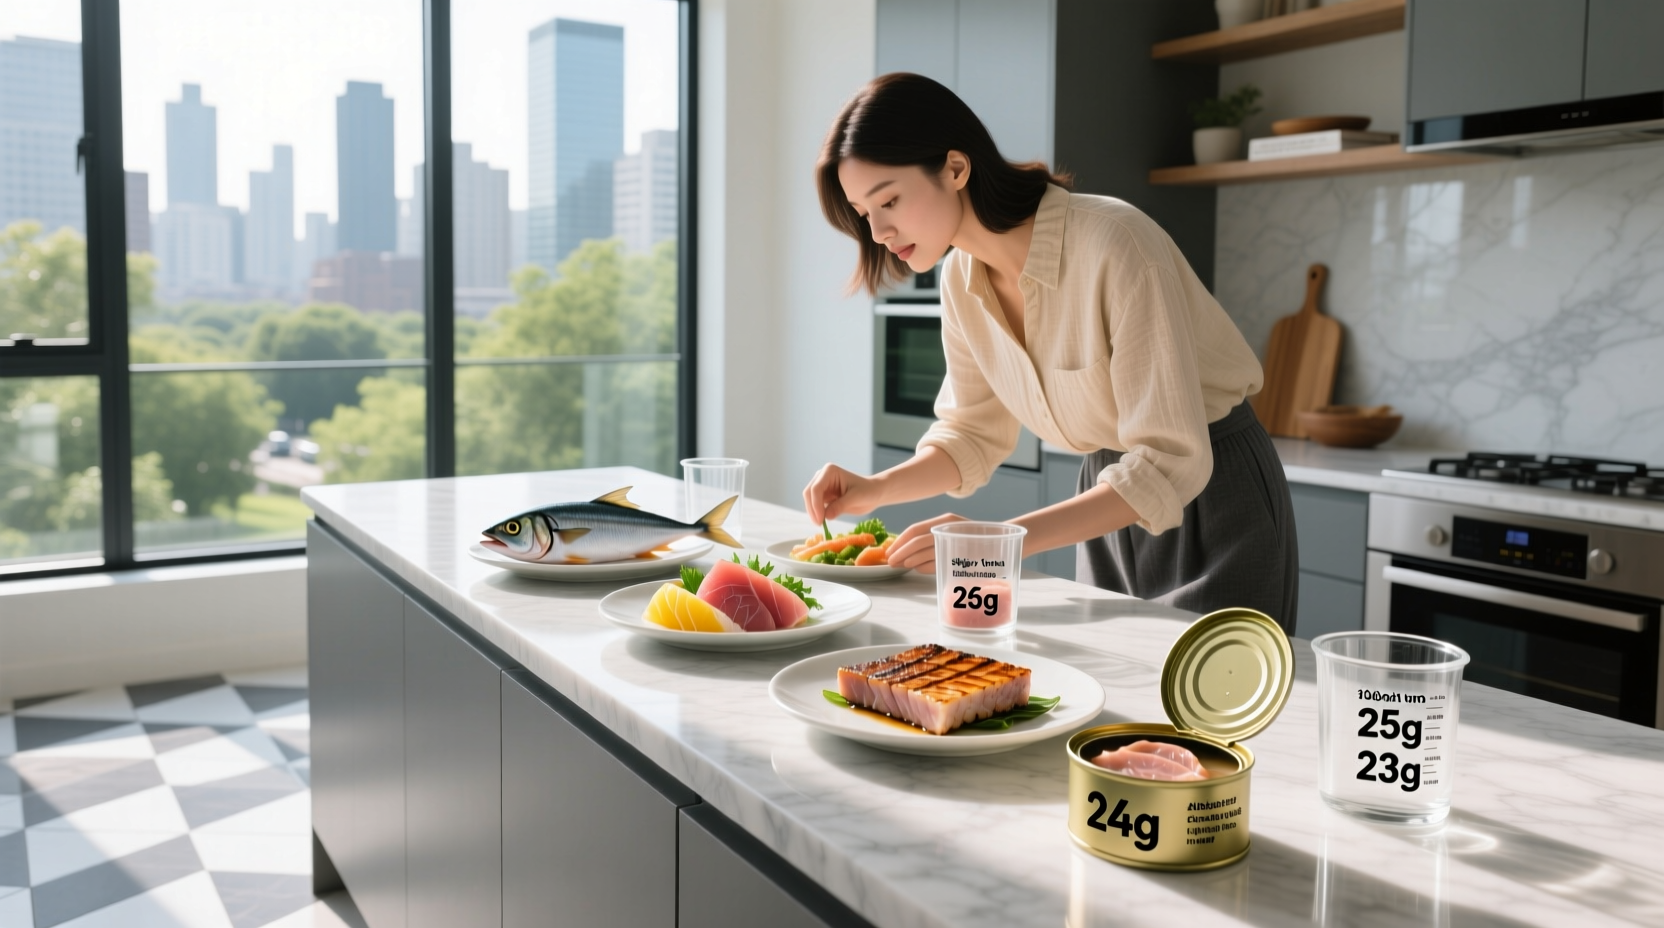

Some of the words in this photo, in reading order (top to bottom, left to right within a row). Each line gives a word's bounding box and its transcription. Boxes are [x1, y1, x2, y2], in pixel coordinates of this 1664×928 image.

[1358, 707, 1422, 749] 25g
[1356, 750, 1420, 792] 23g
[1087, 790, 1159, 851] 24g
